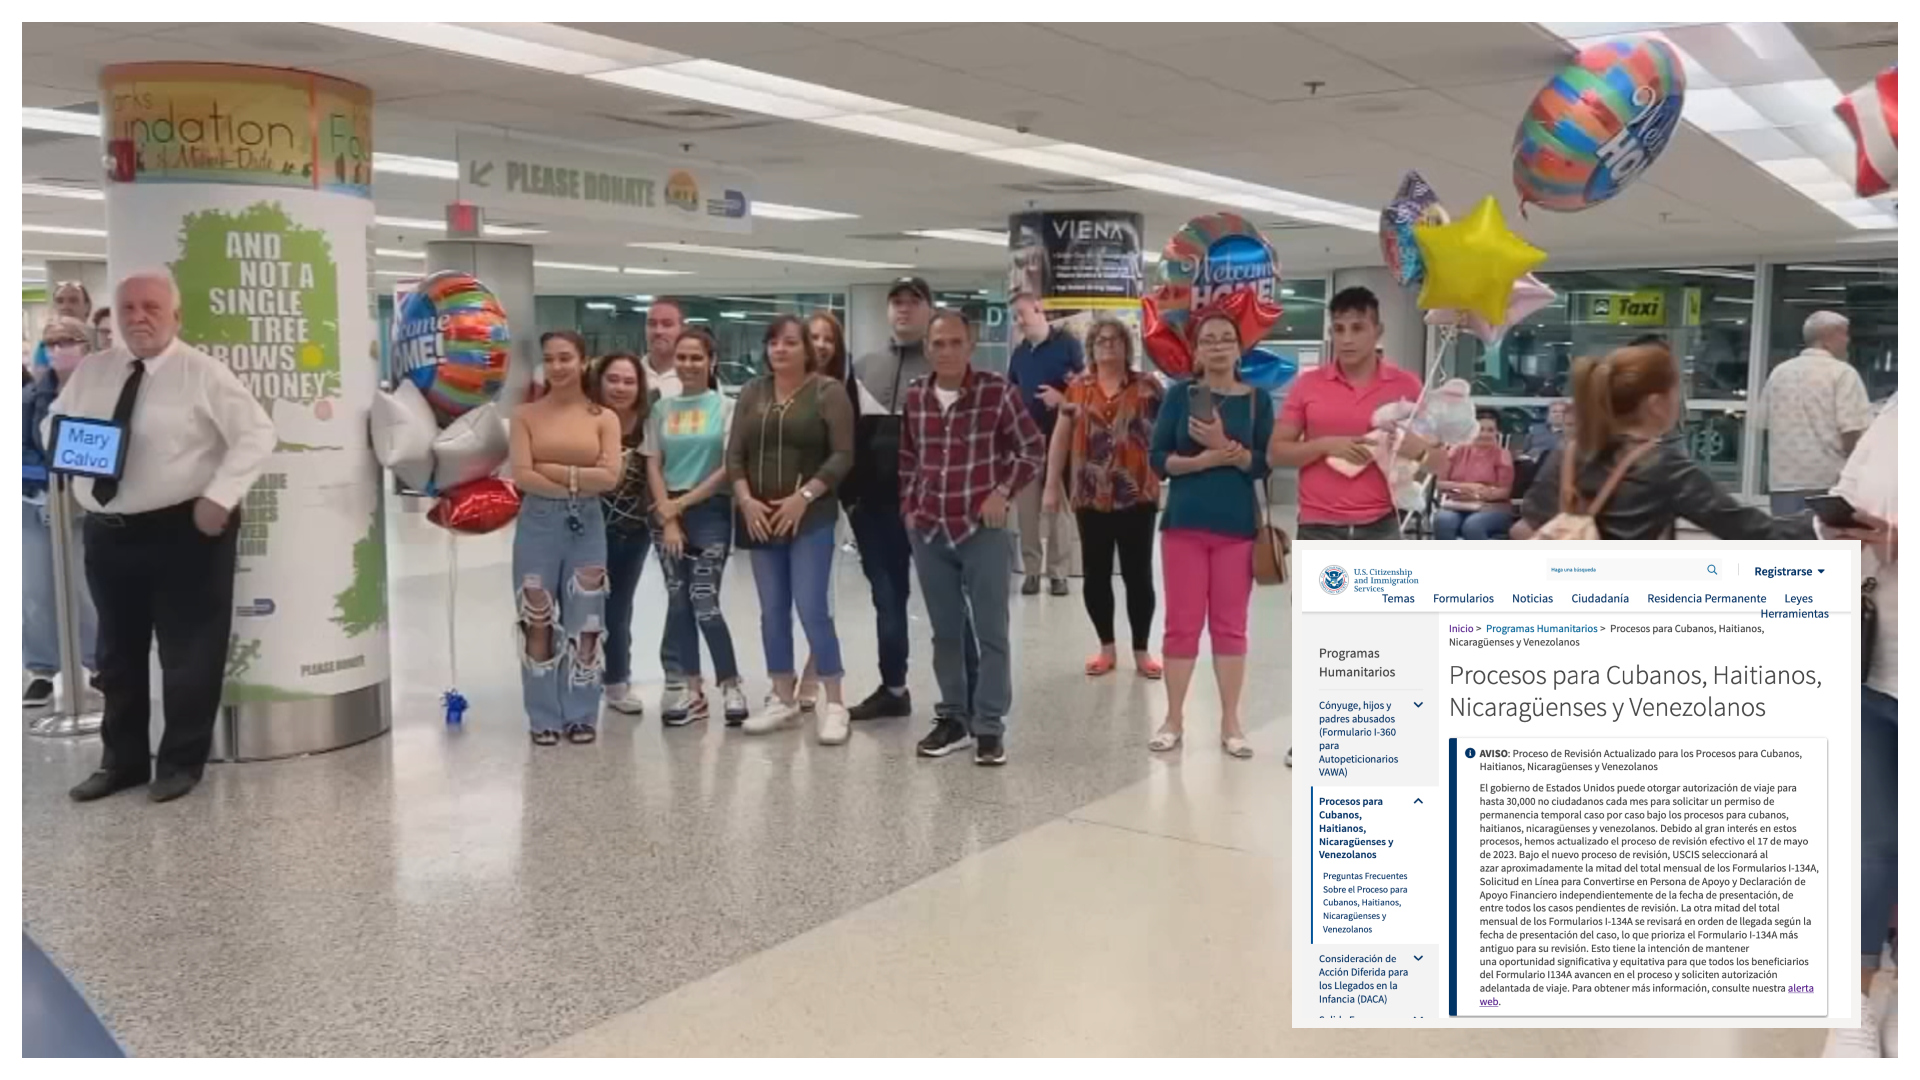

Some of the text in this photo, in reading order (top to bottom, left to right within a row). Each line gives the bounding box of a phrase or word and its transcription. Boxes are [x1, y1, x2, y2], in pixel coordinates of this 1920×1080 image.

[506, 160, 580, 199] PLEASE
[584, 170, 656, 208] DONATE
[226, 231, 281, 260] AND
[240, 260, 314, 288] NOT A
[209, 287, 302, 315] SINGLE
[1619, 296, 1660, 316] Taxi
[247, 316, 309, 343] TREE
[68, 427, 110, 450] Mary
[61, 449, 109, 469] Calvo
